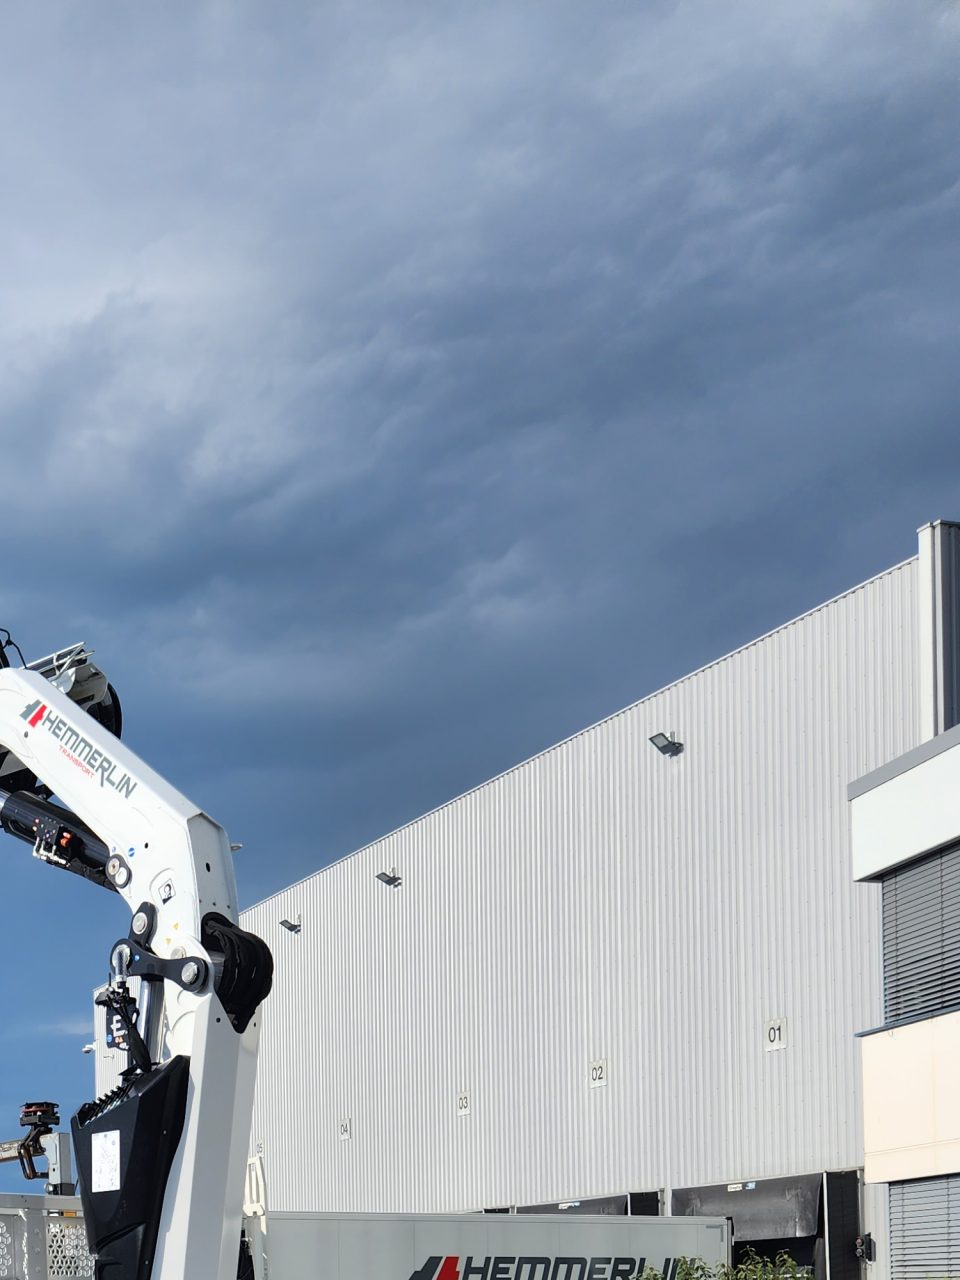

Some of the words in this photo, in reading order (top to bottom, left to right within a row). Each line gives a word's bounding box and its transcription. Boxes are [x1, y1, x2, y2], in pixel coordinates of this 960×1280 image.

[42, 710, 138, 799] HEMMERLIN
[59, 745, 96, 778] TRANSPORT
[768, 1025, 781, 1043] 01
[591, 1066, 603, 1081] 02
[458, 1096, 468, 1110] 03
[340, 1123, 348, 1136] 04
